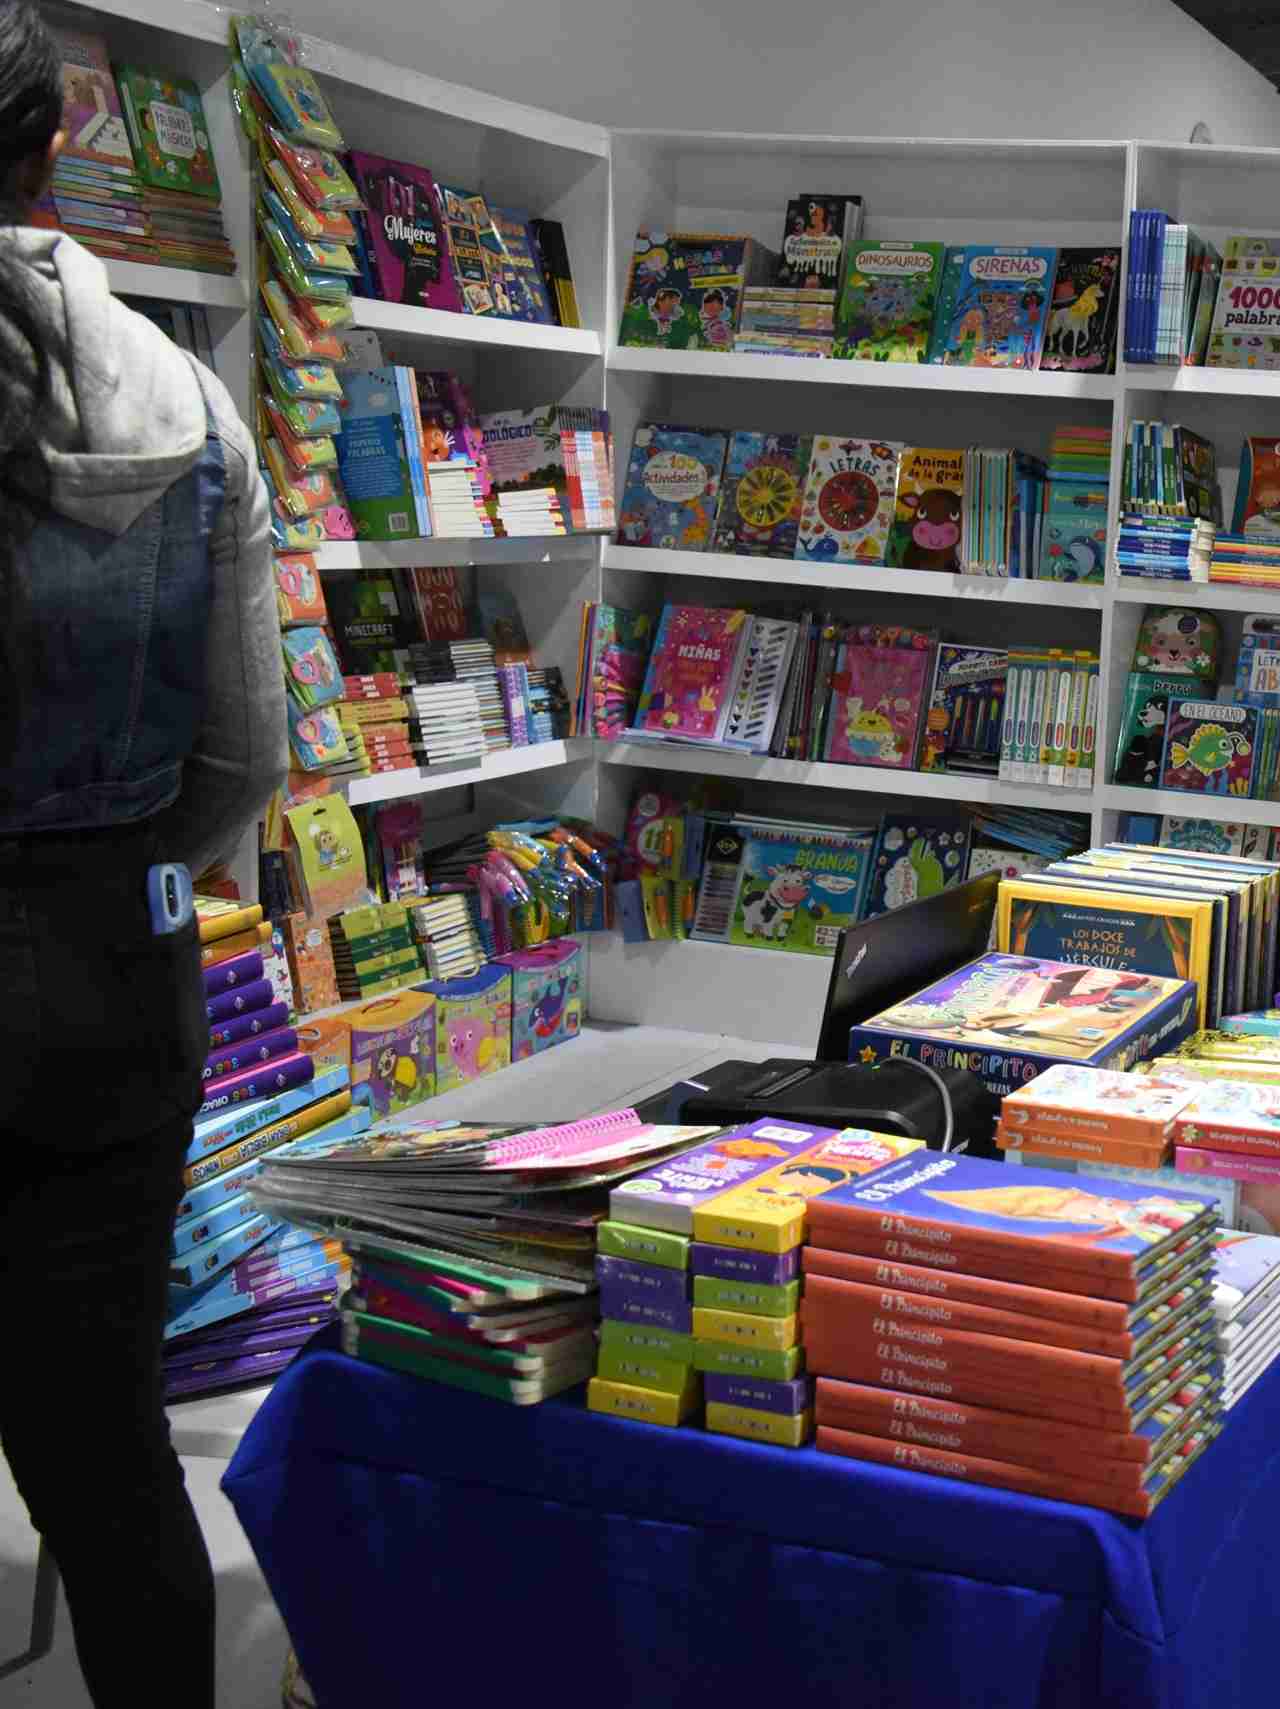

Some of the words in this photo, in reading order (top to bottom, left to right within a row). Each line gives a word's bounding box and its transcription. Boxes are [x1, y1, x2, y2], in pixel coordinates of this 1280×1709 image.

[383, 213, 437, 247] Mujeres
[858, 252, 932, 267] DINOSAURIOS
[975, 257, 1041, 274] SIRENAS
[829, 459, 881, 477] LETRAS
[911, 455, 962, 471] Animal
[344, 622, 394, 637] MINECRAFT
[678, 644, 721, 660] NIÑAS
[795, 848, 859, 873] GRANJA
[1060, 937, 1120, 957] TRABAJOS
[1123, 946, 1137, 959] DE
[1091, 929, 1126, 944] DOCE
[890, 1038, 911, 1058] EL
[920, 1042, 1039, 1083] PRINCIPITO
[874, 1158, 957, 1194] Principito
[896, 1219, 951, 1241] Principito
[901, 1242, 957, 1264] Principito
[891, 1266, 946, 1292] Principito
[896, 1296, 951, 1320] Principito
[888, 1320, 942, 1344] Principito
[893, 1345, 947, 1369] Principito
[896, 1370, 952, 1392] Principito
[909, 1400, 966, 1424] Principito
[905, 1422, 961, 1446] Principito
[910, 1448, 967, 1473] Principito
